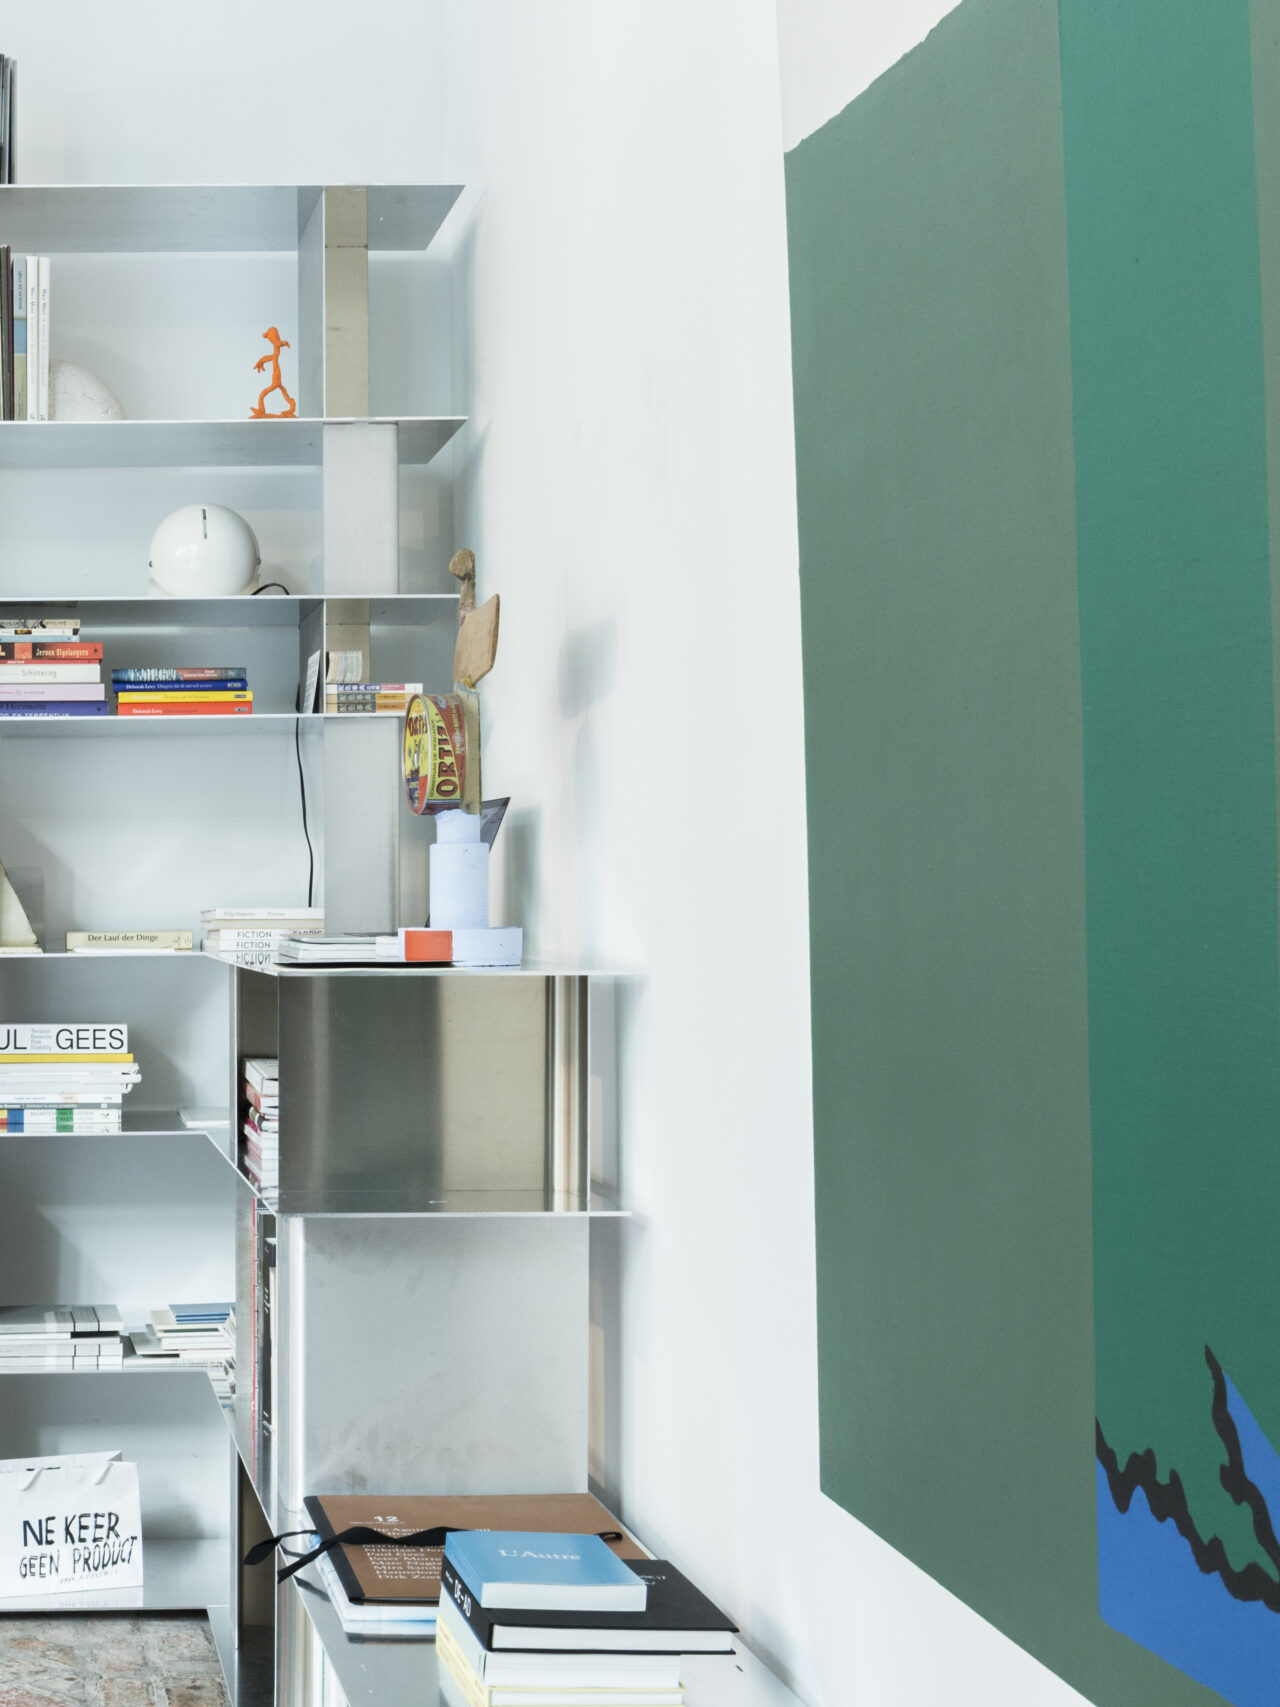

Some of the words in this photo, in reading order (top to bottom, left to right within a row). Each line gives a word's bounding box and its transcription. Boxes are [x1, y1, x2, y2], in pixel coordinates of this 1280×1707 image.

[436, 725, 459, 797] ORTIZ
[136, 934, 159, 943] Dinge
[237, 930, 272, 938] FICTION
[236, 941, 271, 949] FICTION
[55, 1028, 124, 1050] GEES
[22, 1516, 56, 1547] NE
[64, 1512, 121, 1545] KEER
[19, 1550, 60, 1578] GEEN
[72, 1536, 138, 1574] PRODUCT
[499, 1549, 582, 1561] L'Autre
